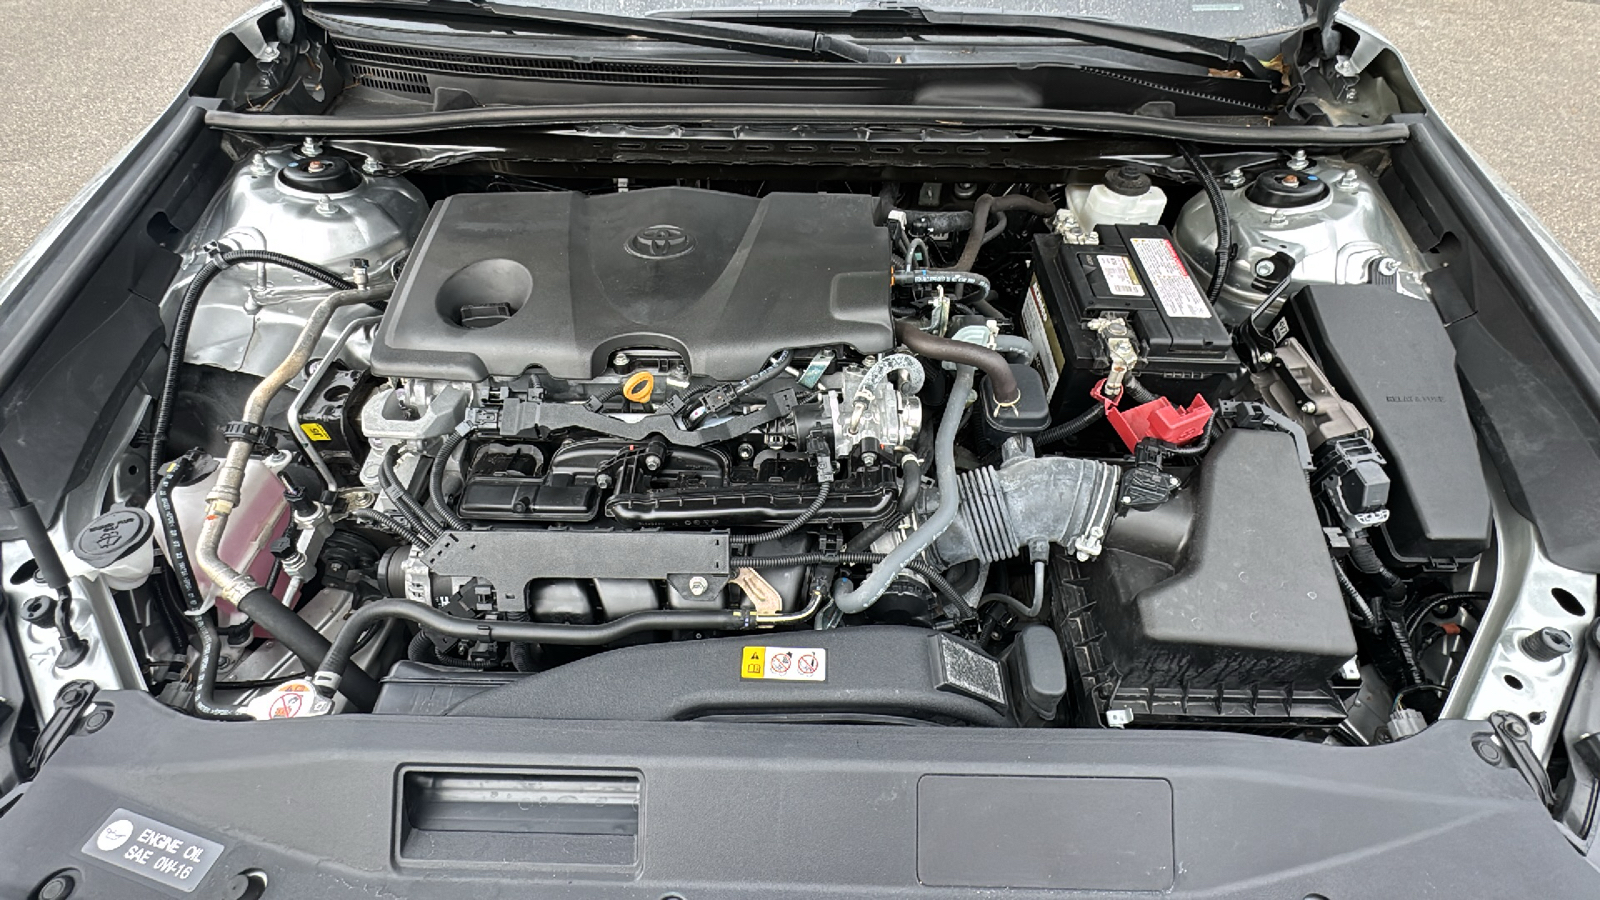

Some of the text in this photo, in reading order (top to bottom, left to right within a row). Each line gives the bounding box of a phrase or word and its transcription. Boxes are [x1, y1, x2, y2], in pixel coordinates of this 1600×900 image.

[123, 845, 194, 880] SAE 0W-16
[137, 828, 204, 863] ENGINE OIL
